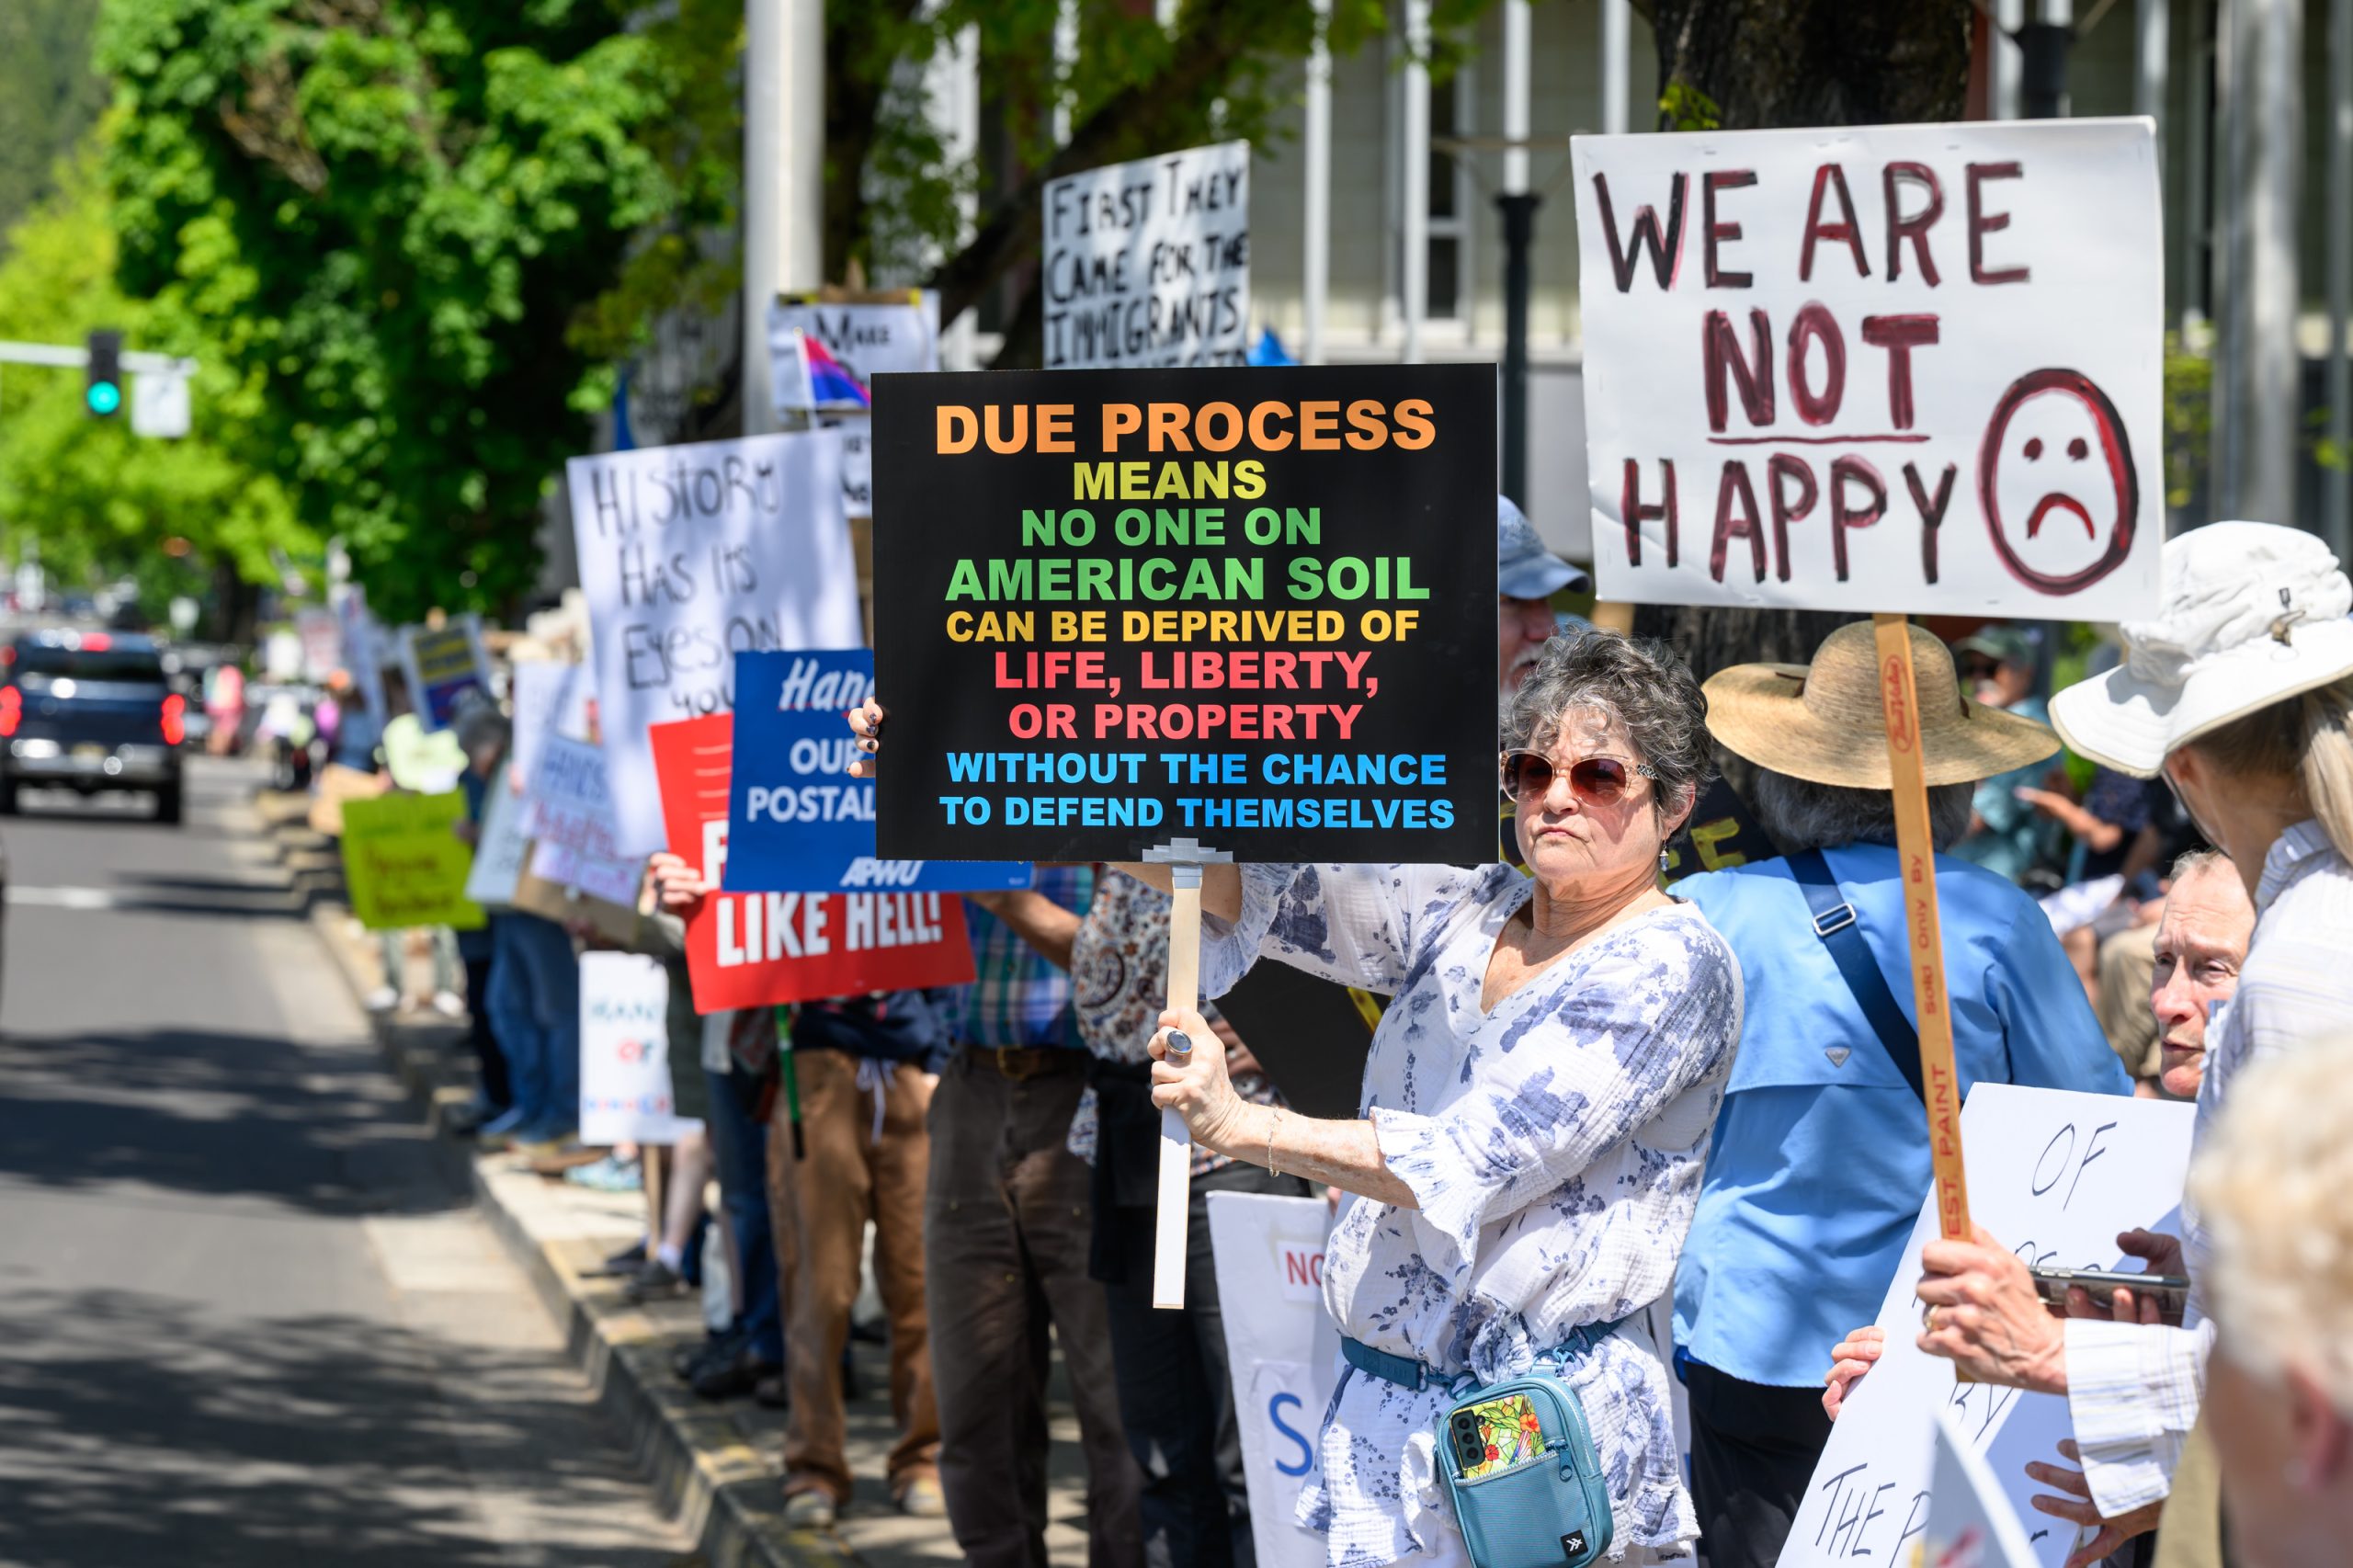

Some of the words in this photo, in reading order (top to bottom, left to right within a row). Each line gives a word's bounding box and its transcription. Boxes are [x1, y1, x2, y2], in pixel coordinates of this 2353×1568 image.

[1052, 181, 1153, 238] FIRST
[1165, 159, 1242, 215] THEY
[1592, 168, 1757, 292] WE
[1799, 161, 2029, 288] ARE
[1048, 249, 1128, 303] CAME
[1149, 242, 1194, 286] FOR
[1204, 233, 1248, 273] THE
[1703, 300, 1939, 433] NOT
[937, 403, 1075, 454] DUE
[1102, 399, 1436, 452] PROCESS
[1074, 460, 1267, 500] MEANS
[1022, 509, 1096, 547] NO
[1114, 508, 1225, 546] ONE
[1245, 507, 1320, 545] ON
[1622, 453, 1958, 585] HAPPY
[946, 558, 1264, 600] AMERICAN
[1287, 556, 1429, 600] SOIL
[946, 611, 1034, 642] CAN
[1051, 611, 1106, 642] BE
[1123, 610, 1345, 642] DEPRIVED
[1360, 610, 1418, 642] OF
[995, 652, 1120, 698] LIFE,
[1142, 652, 1379, 698] LIBERTY,
[1010, 704, 1077, 739] OR
[1095, 704, 1363, 740] PROPERTY
[947, 753, 1146, 783] WITHOUT
[1161, 754, 1246, 784] THE
[1262, 755, 1446, 785] CHANCE
[747, 786, 876, 822] POSTAL
[939, 797, 991, 825] TO
[1005, 798, 1163, 826] DEFEND
[1176, 800, 1454, 829] THEMSELVES
[840, 857, 925, 887] APWU
[1909, 853, 1924, 885] By
[717, 892, 830, 968] LIKE
[846, 892, 942, 951] HELL!
[1915, 898, 1930, 950] Only
[1920, 964, 1938, 1016] Sold
[1931, 1062, 1956, 1157] PAINT
[2031, 1120, 2117, 1211] OF
[1815, 1462, 1896, 1558] THE
